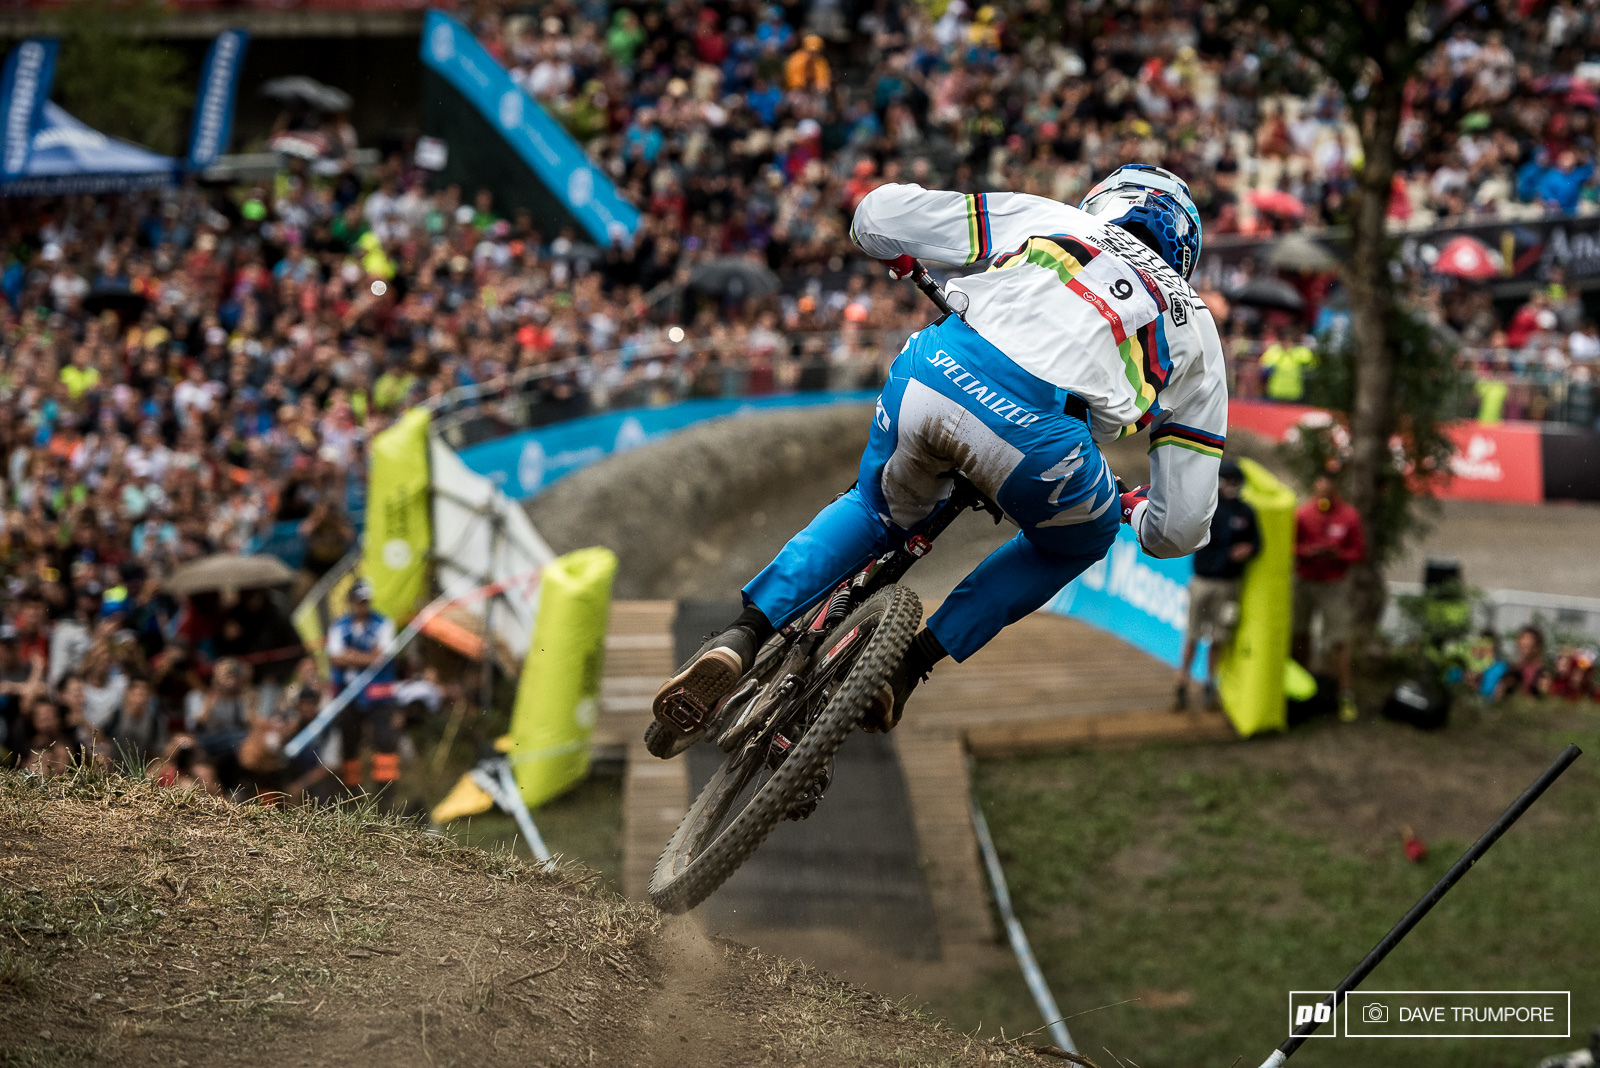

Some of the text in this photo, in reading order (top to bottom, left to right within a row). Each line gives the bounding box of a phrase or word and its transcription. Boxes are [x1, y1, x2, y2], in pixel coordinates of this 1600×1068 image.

[1108, 278, 1134, 301] 9
[1172, 297, 1184, 322] 100%
[926, 349, 1040, 428] SPECIALIZED
